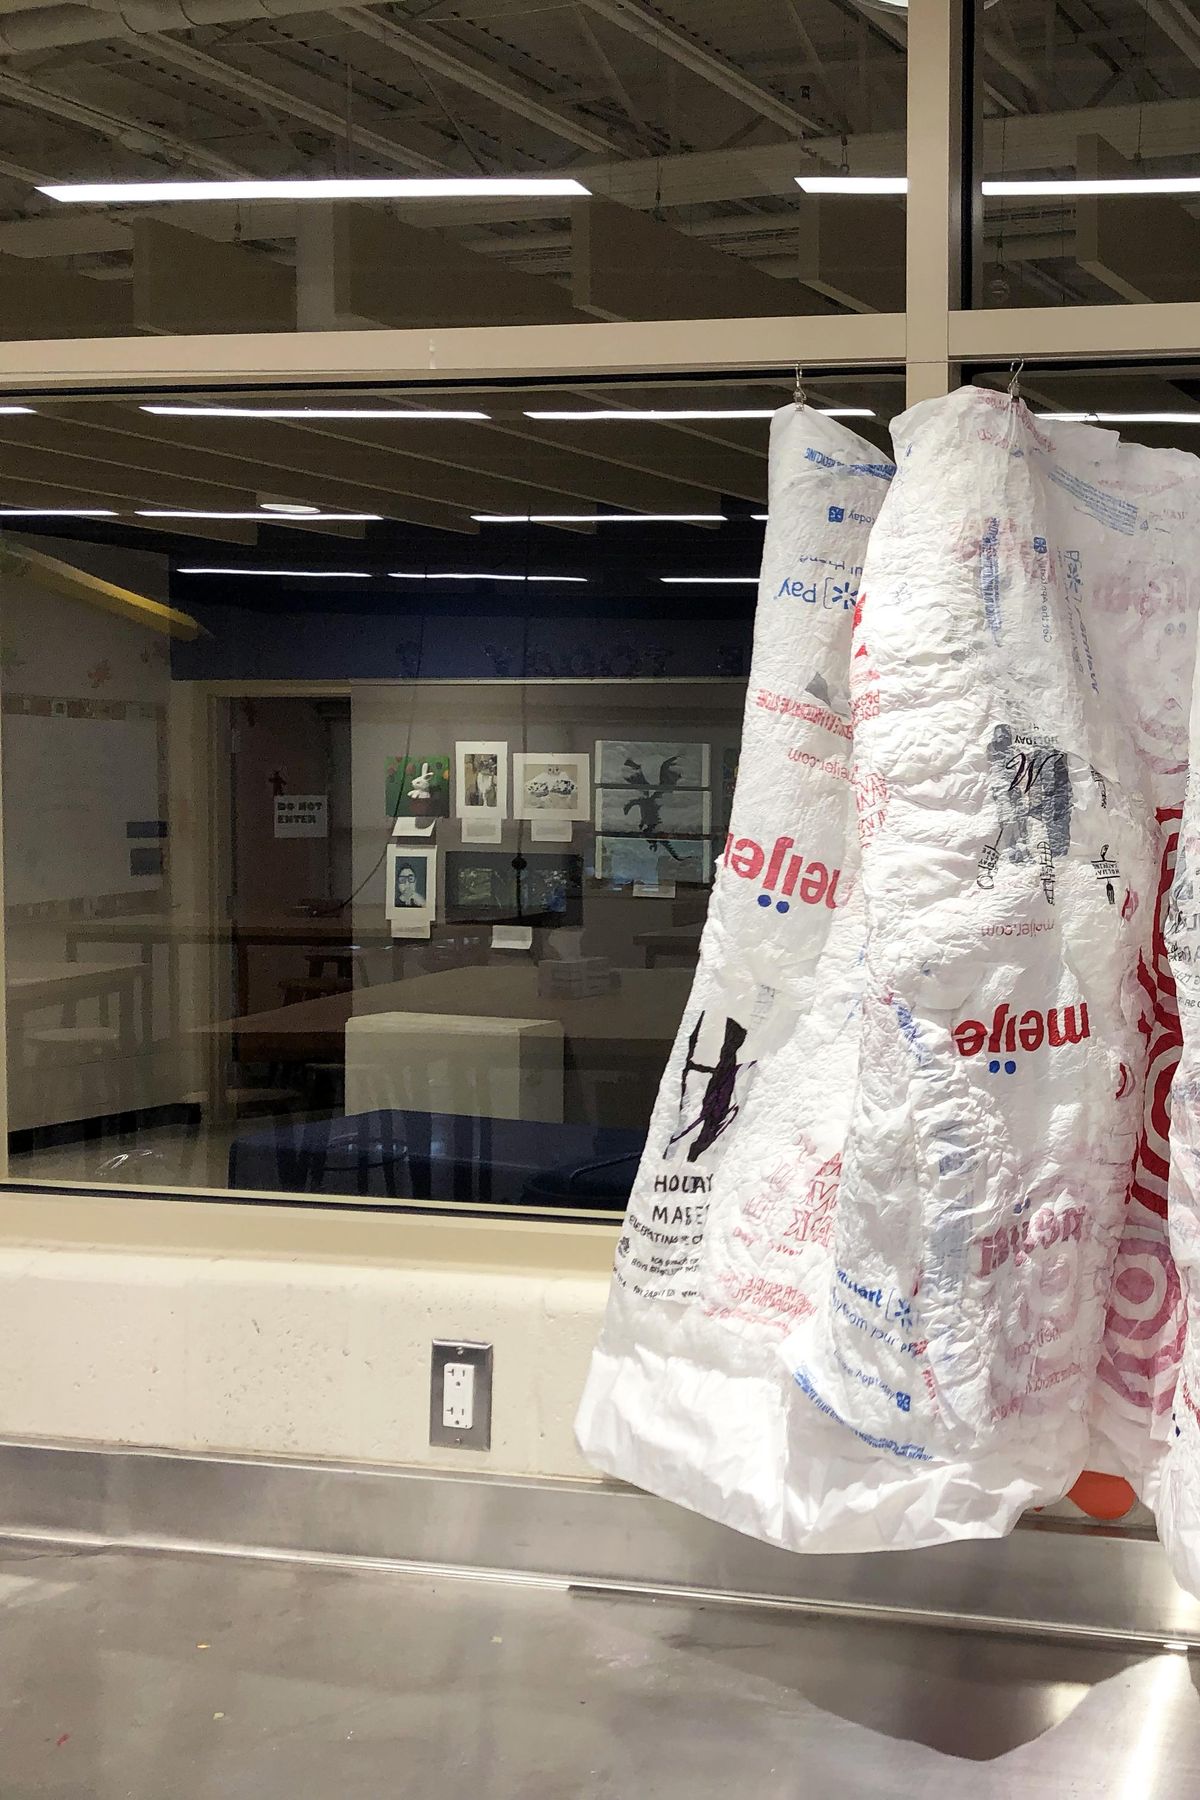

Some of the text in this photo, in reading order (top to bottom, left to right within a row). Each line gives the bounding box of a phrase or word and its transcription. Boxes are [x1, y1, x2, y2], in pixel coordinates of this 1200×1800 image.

[778, 576, 818, 605] Pay
[277, 801, 322, 811] DO NOT
[277, 814, 316, 824] ENTER
